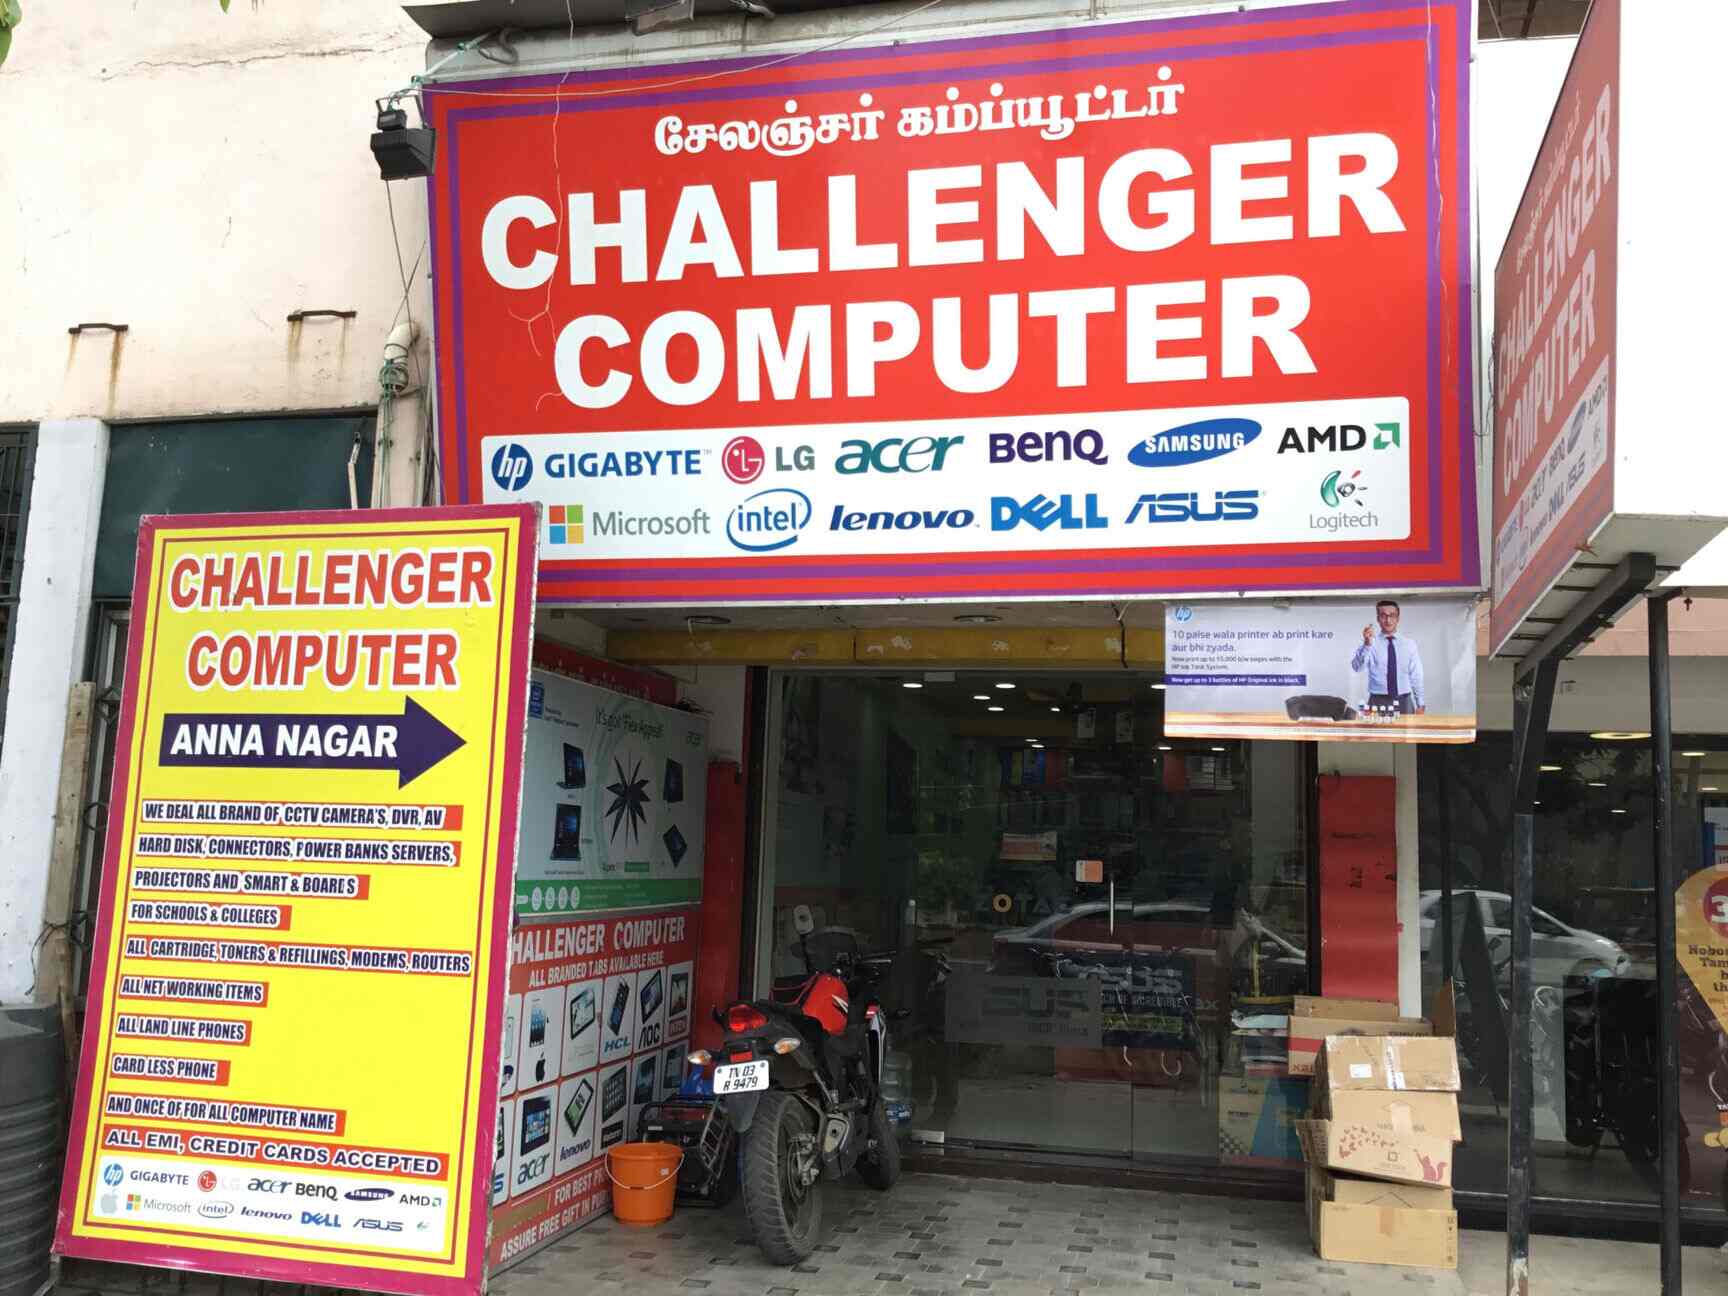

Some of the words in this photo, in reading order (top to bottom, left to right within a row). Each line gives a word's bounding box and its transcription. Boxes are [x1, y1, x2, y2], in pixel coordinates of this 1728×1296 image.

[654, 93, 885, 157] சேலஞ்சர்
[897, 66, 1185, 141] கம்ப்யூட்டர்
[480, 131, 1407, 291] CHALLENGER
[1498, 83, 1612, 412] CHALLENGER
[553, 273, 1318, 409] COMPUTER
[1503, 248, 1597, 497] COMPUTER
[492, 443, 533, 491] hp
[544, 449, 702, 479] GIGABYTE
[775, 445, 816, 473] LG
[834, 434, 966, 475] acer
[1144, 431, 1245, 456] SAMSUNG
[1277, 424, 1367, 454] AMD
[591, 504, 711, 537] Microsoft
[829, 503, 974, 532] lenovo
[990, 492, 1109, 532] DELL
[1124, 489, 1259, 525] ASUS
[1309, 511, 1379, 533] Logitech
[168, 548, 496, 611] CHALLENGER
[1171, 644, 1187, 653] aur
[1189, 642, 1203, 653] bhi
[1172, 630, 1184, 640] 10
[1186, 629, 1211, 641] paise
[1213, 629, 1235, 640] wala
[1237, 629, 1270, 641] printer
[1272, 629, 1285, 639] ab
[1286, 629, 1309, 641] print
[1311, 629, 1334, 640] kare
[186, 631, 460, 690] COMPUTER
[170, 723, 265, 757] ANNA
[275, 723, 398, 759] NAGAR
[144, 803, 166, 820] WE
[165, 803, 194, 821] DEAL
[195, 804, 218, 821] ALL
[219, 804, 262, 822] BRAND
[263, 805, 280, 822] OF
[284, 805, 318, 823] CCTV
[321, 806, 389, 827] CAMERA'S,
[391, 808, 422, 827] DVR,
[424, 808, 443, 826] AV
[138, 836, 172, 854] HARD
[208, 838, 293, 860] CONNECTORS,
[344, 841, 389, 860] BANKS
[390, 841, 454, 864] SERVERS,
[134, 870, 211, 890] PROJECTORS
[212, 871, 239, 890] AND
[243, 872, 289, 892] SMART
[289, 877, 301, 893] &
[130, 903, 153, 920] FOR
[154, 904, 208, 922] SCHOOLS
[220, 906, 278, 926] COLLEGES
[126, 938, 147, 956] ALL
[150, 940, 218, 961] CARTRIDGE,
[220, 943, 266, 962] TONERS
[278, 947, 349, 969] REFILLINGS,
[351, 950, 410, 971] MODEMS,
[411, 953, 470, 973] ROUTERS
[511, 923, 605, 965] HALLENGER
[613, 916, 686, 950] COMPUTER
[528, 969, 545, 988] ALL
[547, 962, 587, 985] BRANDED
[588, 959, 608, 977] TABS
[608, 953, 646, 975] AVAILABLE
[646, 951, 664, 968] HERE
[121, 977, 143, 994] ALL
[142, 978, 165, 996] NET
[166, 980, 223, 999] WORKING
[224, 983, 262, 1002] ITEMS
[117, 1016, 138, 1033] ALL
[138, 1017, 169, 1036] LAND
[170, 1019, 196, 1038] LINE
[197, 1021, 245, 1041] PHONES
[604, 1036, 631, 1053] HCL
[113, 1055, 145, 1075] CARD
[146, 1057, 175, 1077] LESS
[176, 1059, 216, 1079] PHONE
[722, 1080, 731, 1091] R
[733, 1076, 758, 1090] 9479
[742, 1064, 756, 1077] 03
[107, 1096, 133, 1113] AND
[133, 1097, 165, 1116] ONCE
[166, 1099, 183, 1118] OF
[183, 1101, 207, 1120] FOR
[208, 1102, 229, 1121] ALL
[230, 1105, 297, 1128] COMPUTER
[299, 1110, 335, 1131] NAME
[106, 1130, 141, 1147] ALL
[145, 1132, 184, 1154] EMI,
[189, 1136, 259, 1158] CREDIT
[263, 1143, 329, 1164] CARDS
[333, 1149, 440, 1175] ACCEPTED
[517, 1153, 551, 1185] acer
[559, 1138, 592, 1161] lenovo
[130, 1169, 189, 1186] GIGABYTE
[247, 1177, 293, 1194] acer
[399, 1193, 431, 1207] AMD
[553, 1183, 571, 1206] FOR
[572, 1172, 593, 1197] BEST
[143, 1199, 192, 1214] Microsoft
[241, 1206, 293, 1222] lenovo
[300, 1211, 342, 1229] DELL
[352, 1218, 404, 1232] ASUS
[500, 1225, 537, 1262] ASSURE
[538, 1212, 561, 1241] FREE
[561, 1202, 580, 1227] GIFT
